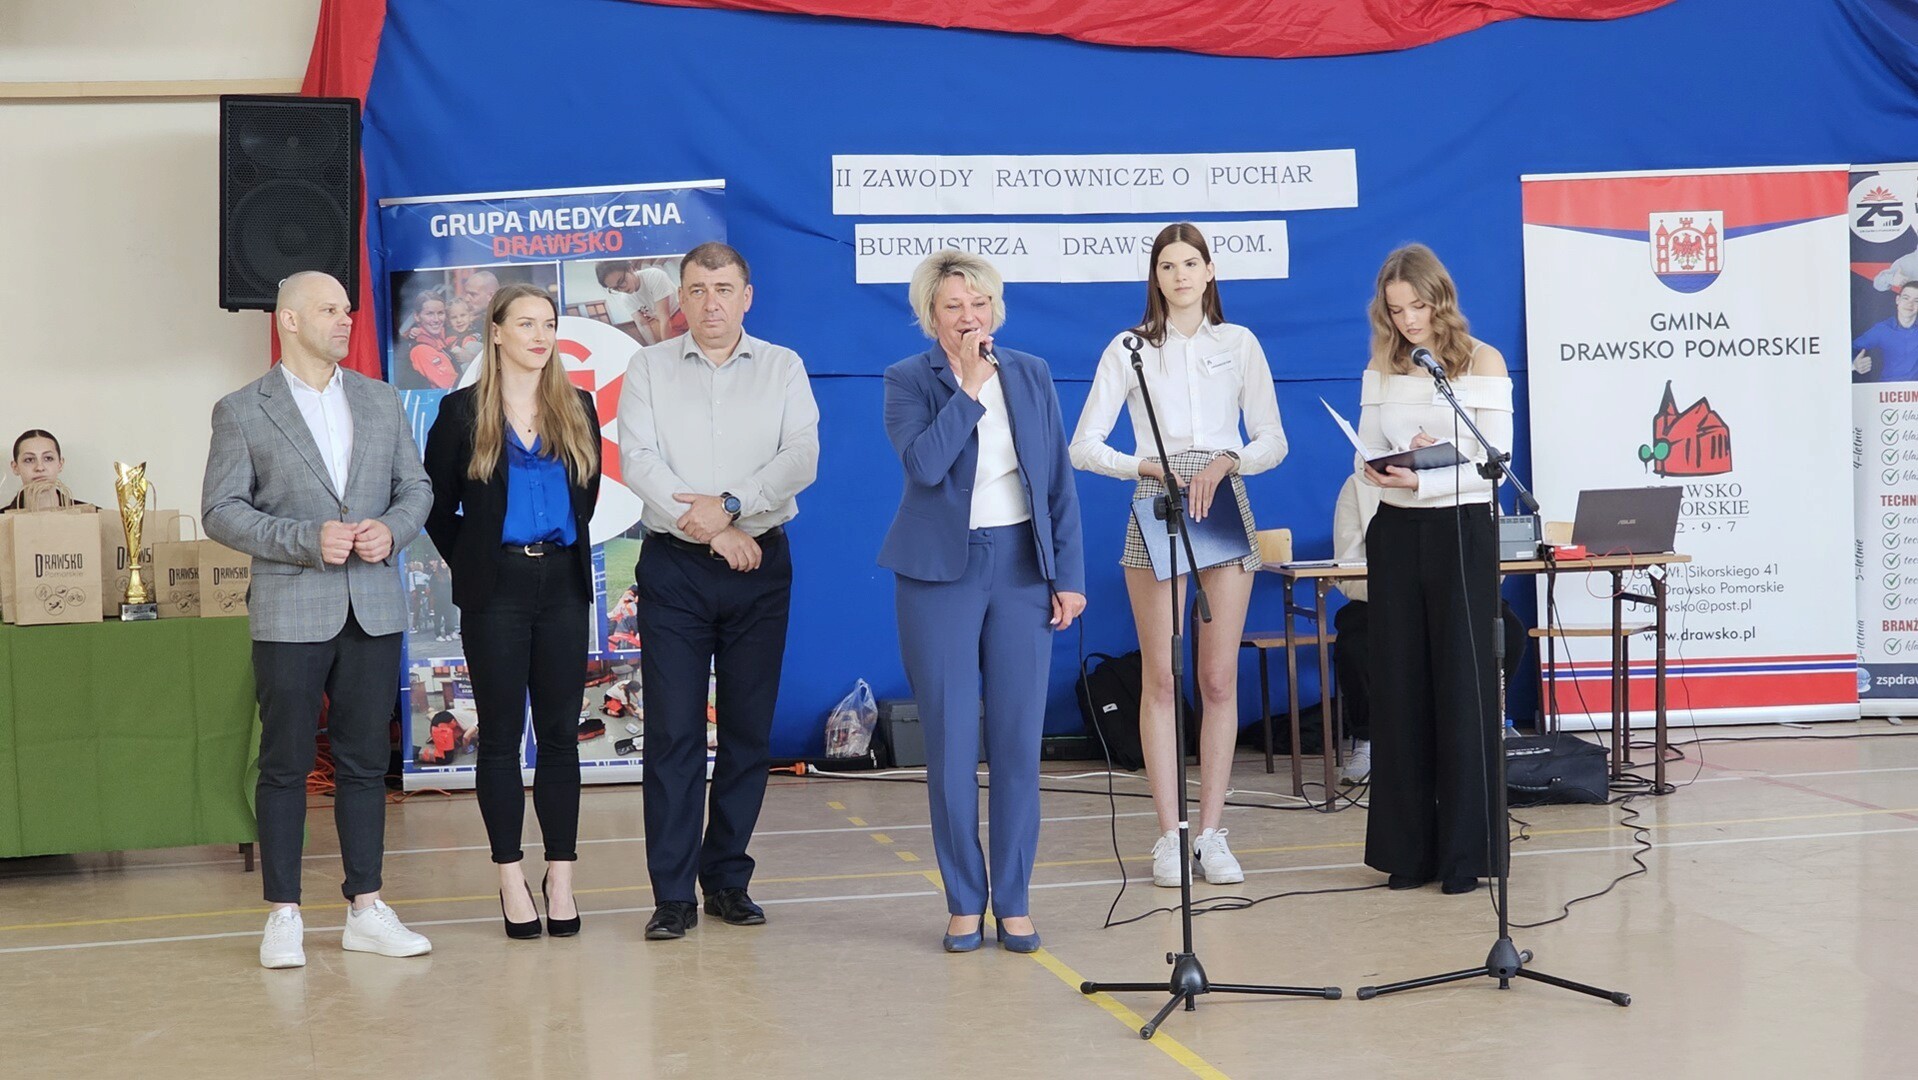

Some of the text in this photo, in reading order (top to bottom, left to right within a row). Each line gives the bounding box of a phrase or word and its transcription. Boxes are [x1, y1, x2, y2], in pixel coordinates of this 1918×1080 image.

[836, 165, 1313, 188] II ZAWODY RATOWNICZE O PUCHAR
[430, 202, 682, 238] GRUPA MEDYCZNA
[492, 230, 623, 258] DRAWSKO
[859, 234, 1272, 256] BURMISTRZA DRAWS POM.
[1650, 311, 1730, 332] GMINA
[1560, 336, 1821, 362] DRAWSKO POMORSKIE
[1680, 500, 1750, 516] ORSKIE
[35, 553, 83, 578] DRAWSKO
[213, 567, 248, 585] DRAWSKO
[1689, 564, 1760, 579] Sikorskiego
[1764, 563, 1779, 576] 41
[169, 568, 199, 586] DRAWSK
[1664, 582, 1716, 595] Drawsko
[1720, 581, 1785, 594] Pomorskie
[1643, 598, 1752, 614] drwsko@post.pl
